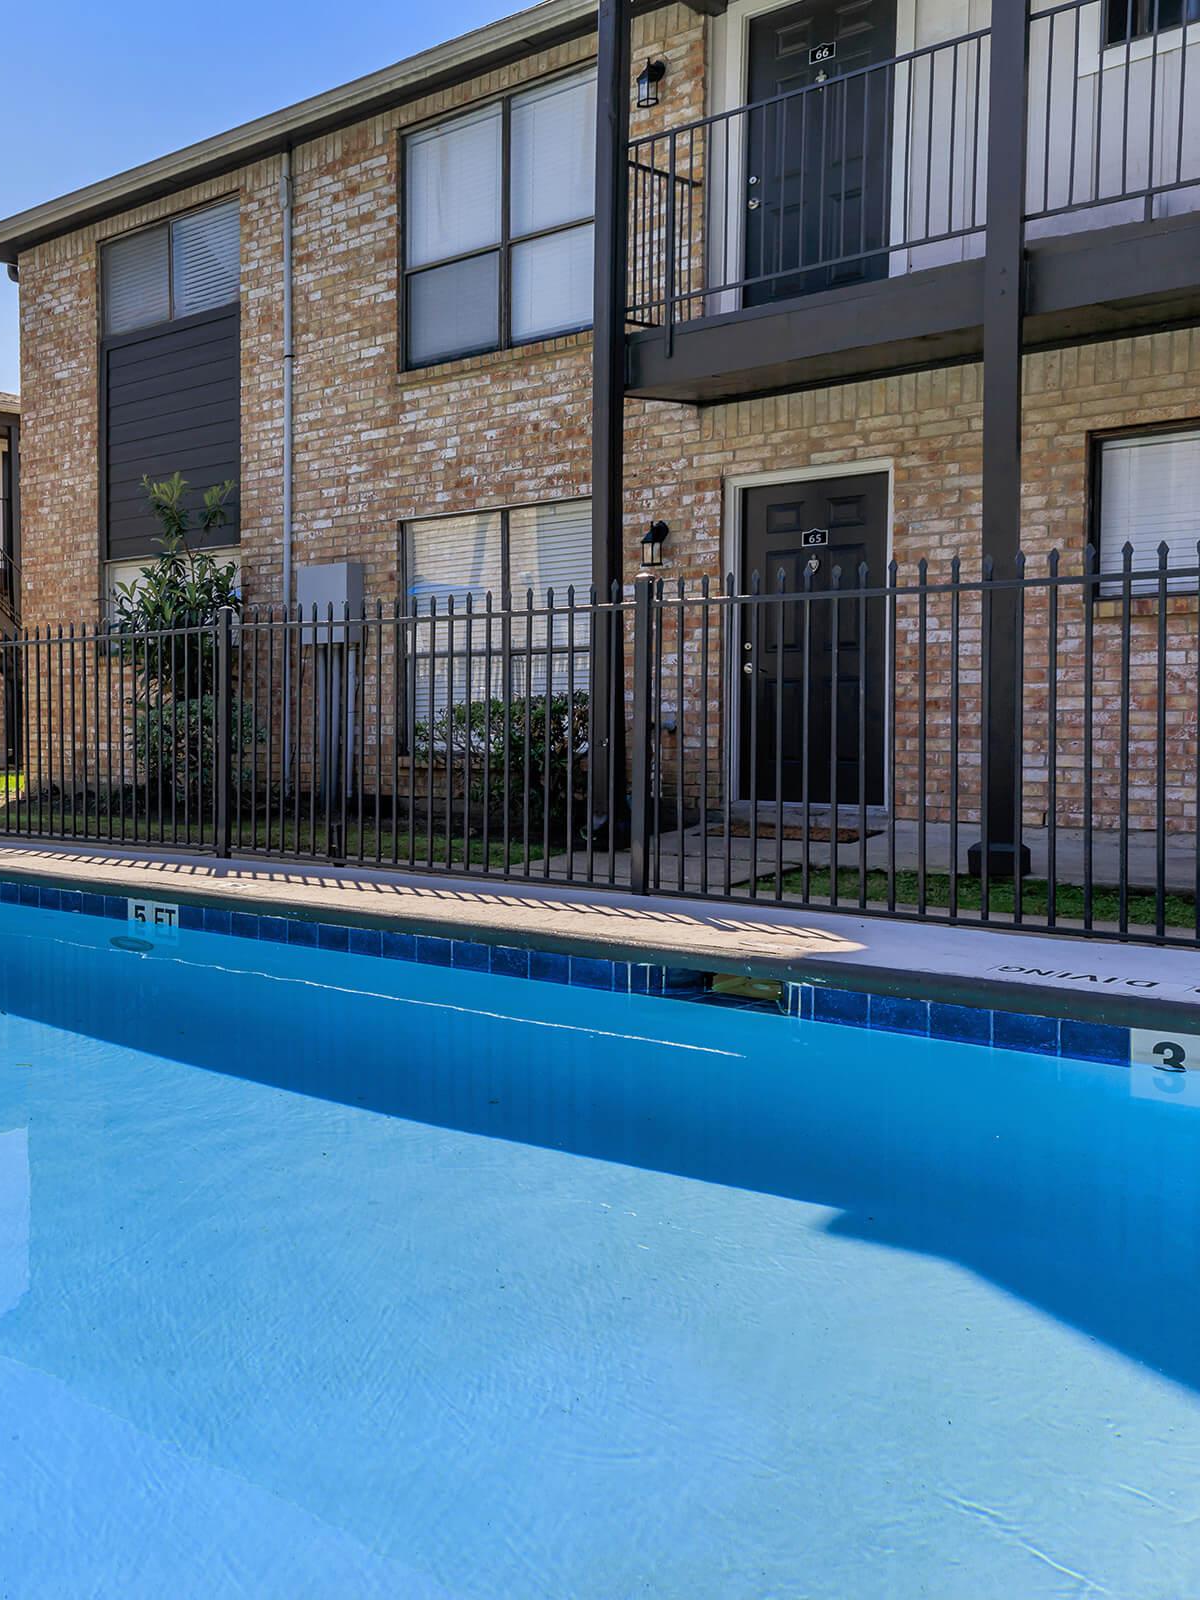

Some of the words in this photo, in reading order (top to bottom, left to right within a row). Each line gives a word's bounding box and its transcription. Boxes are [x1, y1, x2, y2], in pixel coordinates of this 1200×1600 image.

[815, 48, 829, 60] 66
[808, 534, 822, 543] 65
[134, 904, 146, 922] 5
[154, 907, 176, 926] FT
[999, 965, 1160, 988] DIVING
[1152, 1041, 1187, 1072] 3
